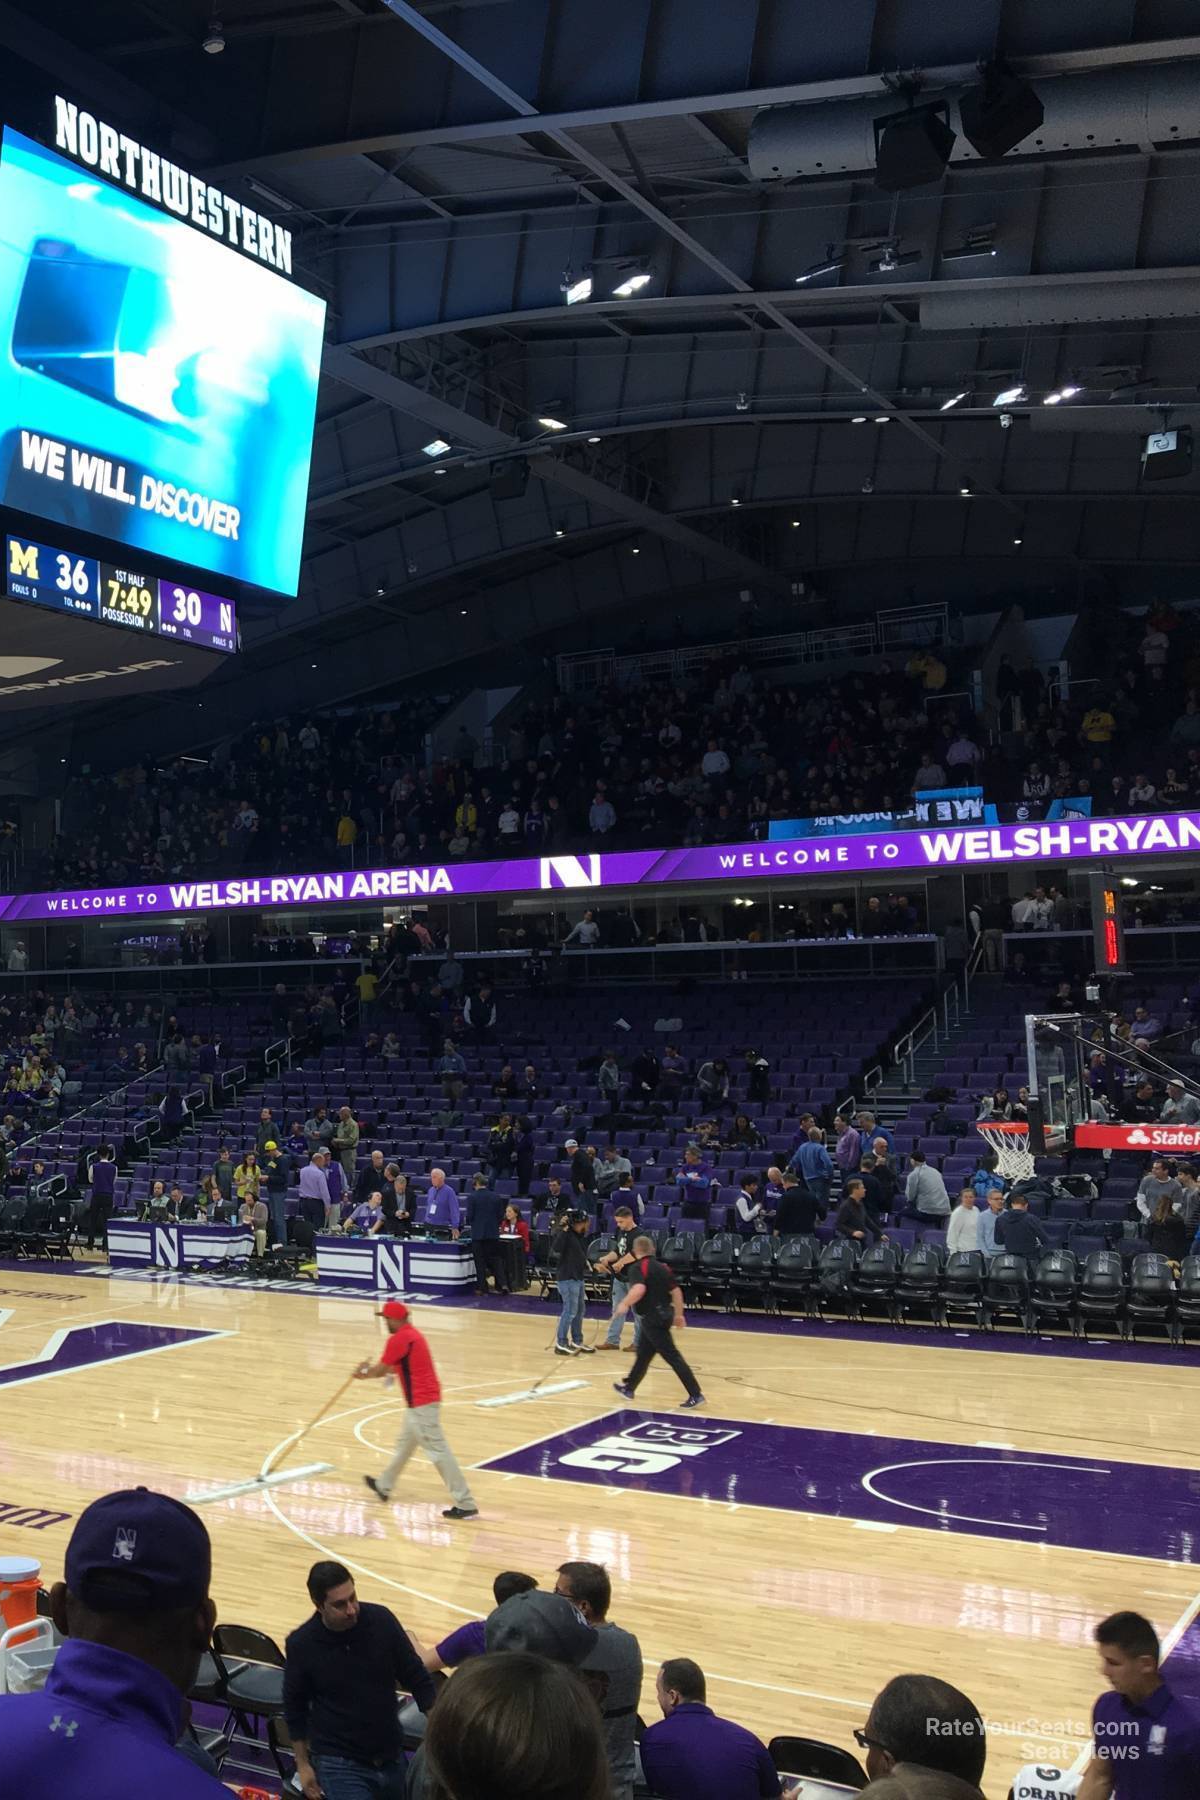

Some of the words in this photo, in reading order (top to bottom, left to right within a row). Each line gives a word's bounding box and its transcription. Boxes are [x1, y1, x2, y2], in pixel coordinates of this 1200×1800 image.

[55, 95, 292, 275] NORTHWESTERN
[21, 430, 66, 480] WE
[71, 448, 136, 504] WILL.
[139, 475, 241, 540] DISCOVER
[9, 540, 40, 580] M
[55, 554, 89, 595] 36
[12, 583, 29, 596] FOULS
[32, 587, 37, 599] 0
[115, 569, 127, 581] 1ST
[128, 571, 145, 588] HALF
[64, 596, 74, 607] TOL
[107, 580, 152, 616] 7:49
[173, 588, 201, 625] 30
[102, 606, 144, 628] POSSESSION
[183, 628, 192, 638] TOL
[220, 603, 232, 633] N
[212, 635, 227, 647] FOULS
[540, 854, 601, 889] N
[718, 846, 849, 868] WELCOME
[866, 843, 899, 859] TO
[46, 896, 128, 911] WELCOME
[136, 893, 157, 906] TO
[169, 874, 344, 908] WELSH-RYAN
[349, 867, 454, 896] ARENA
[154, 1227, 179, 1267] N
[377, 1244, 405, 1290] N
